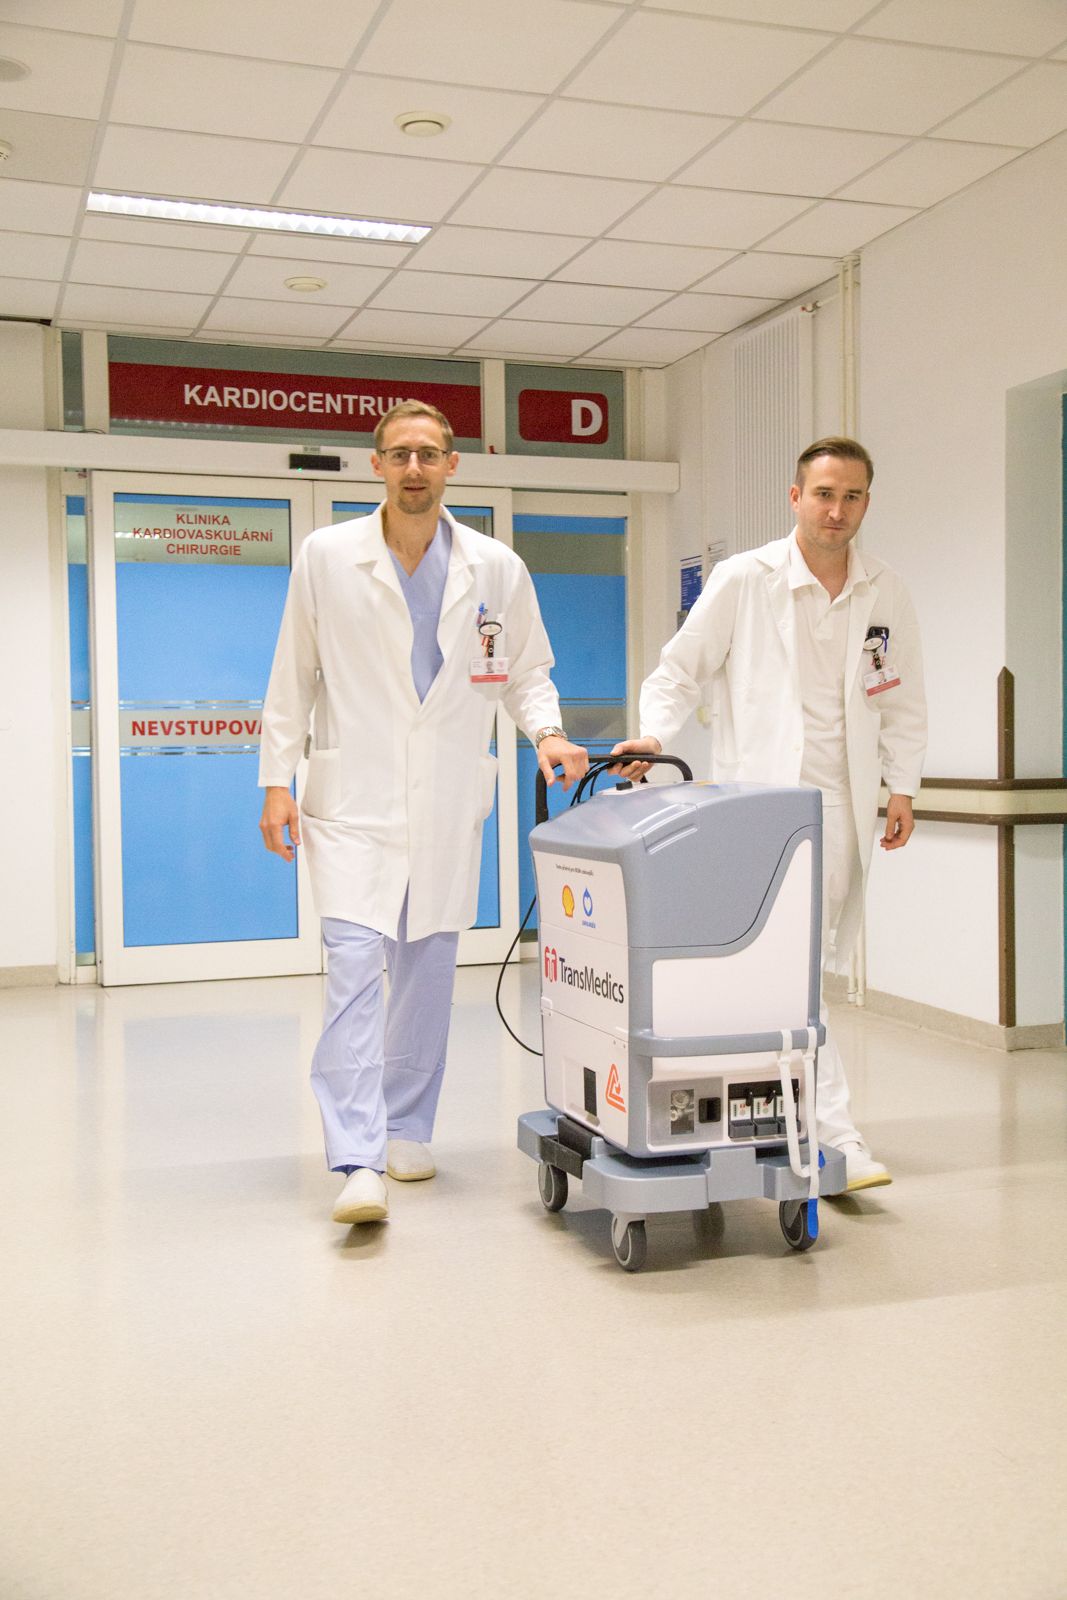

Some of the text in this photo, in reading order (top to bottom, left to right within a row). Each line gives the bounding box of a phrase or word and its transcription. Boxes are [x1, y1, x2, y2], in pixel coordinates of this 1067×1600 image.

[571, 399, 603, 436] D
[176, 513, 231, 526] KLINIKA
[133, 527, 273, 542] KARDIOVASKULÁRNÍ
[166, 543, 241, 556] CHIRURGIE
[559, 956, 624, 1004] TransMedics
